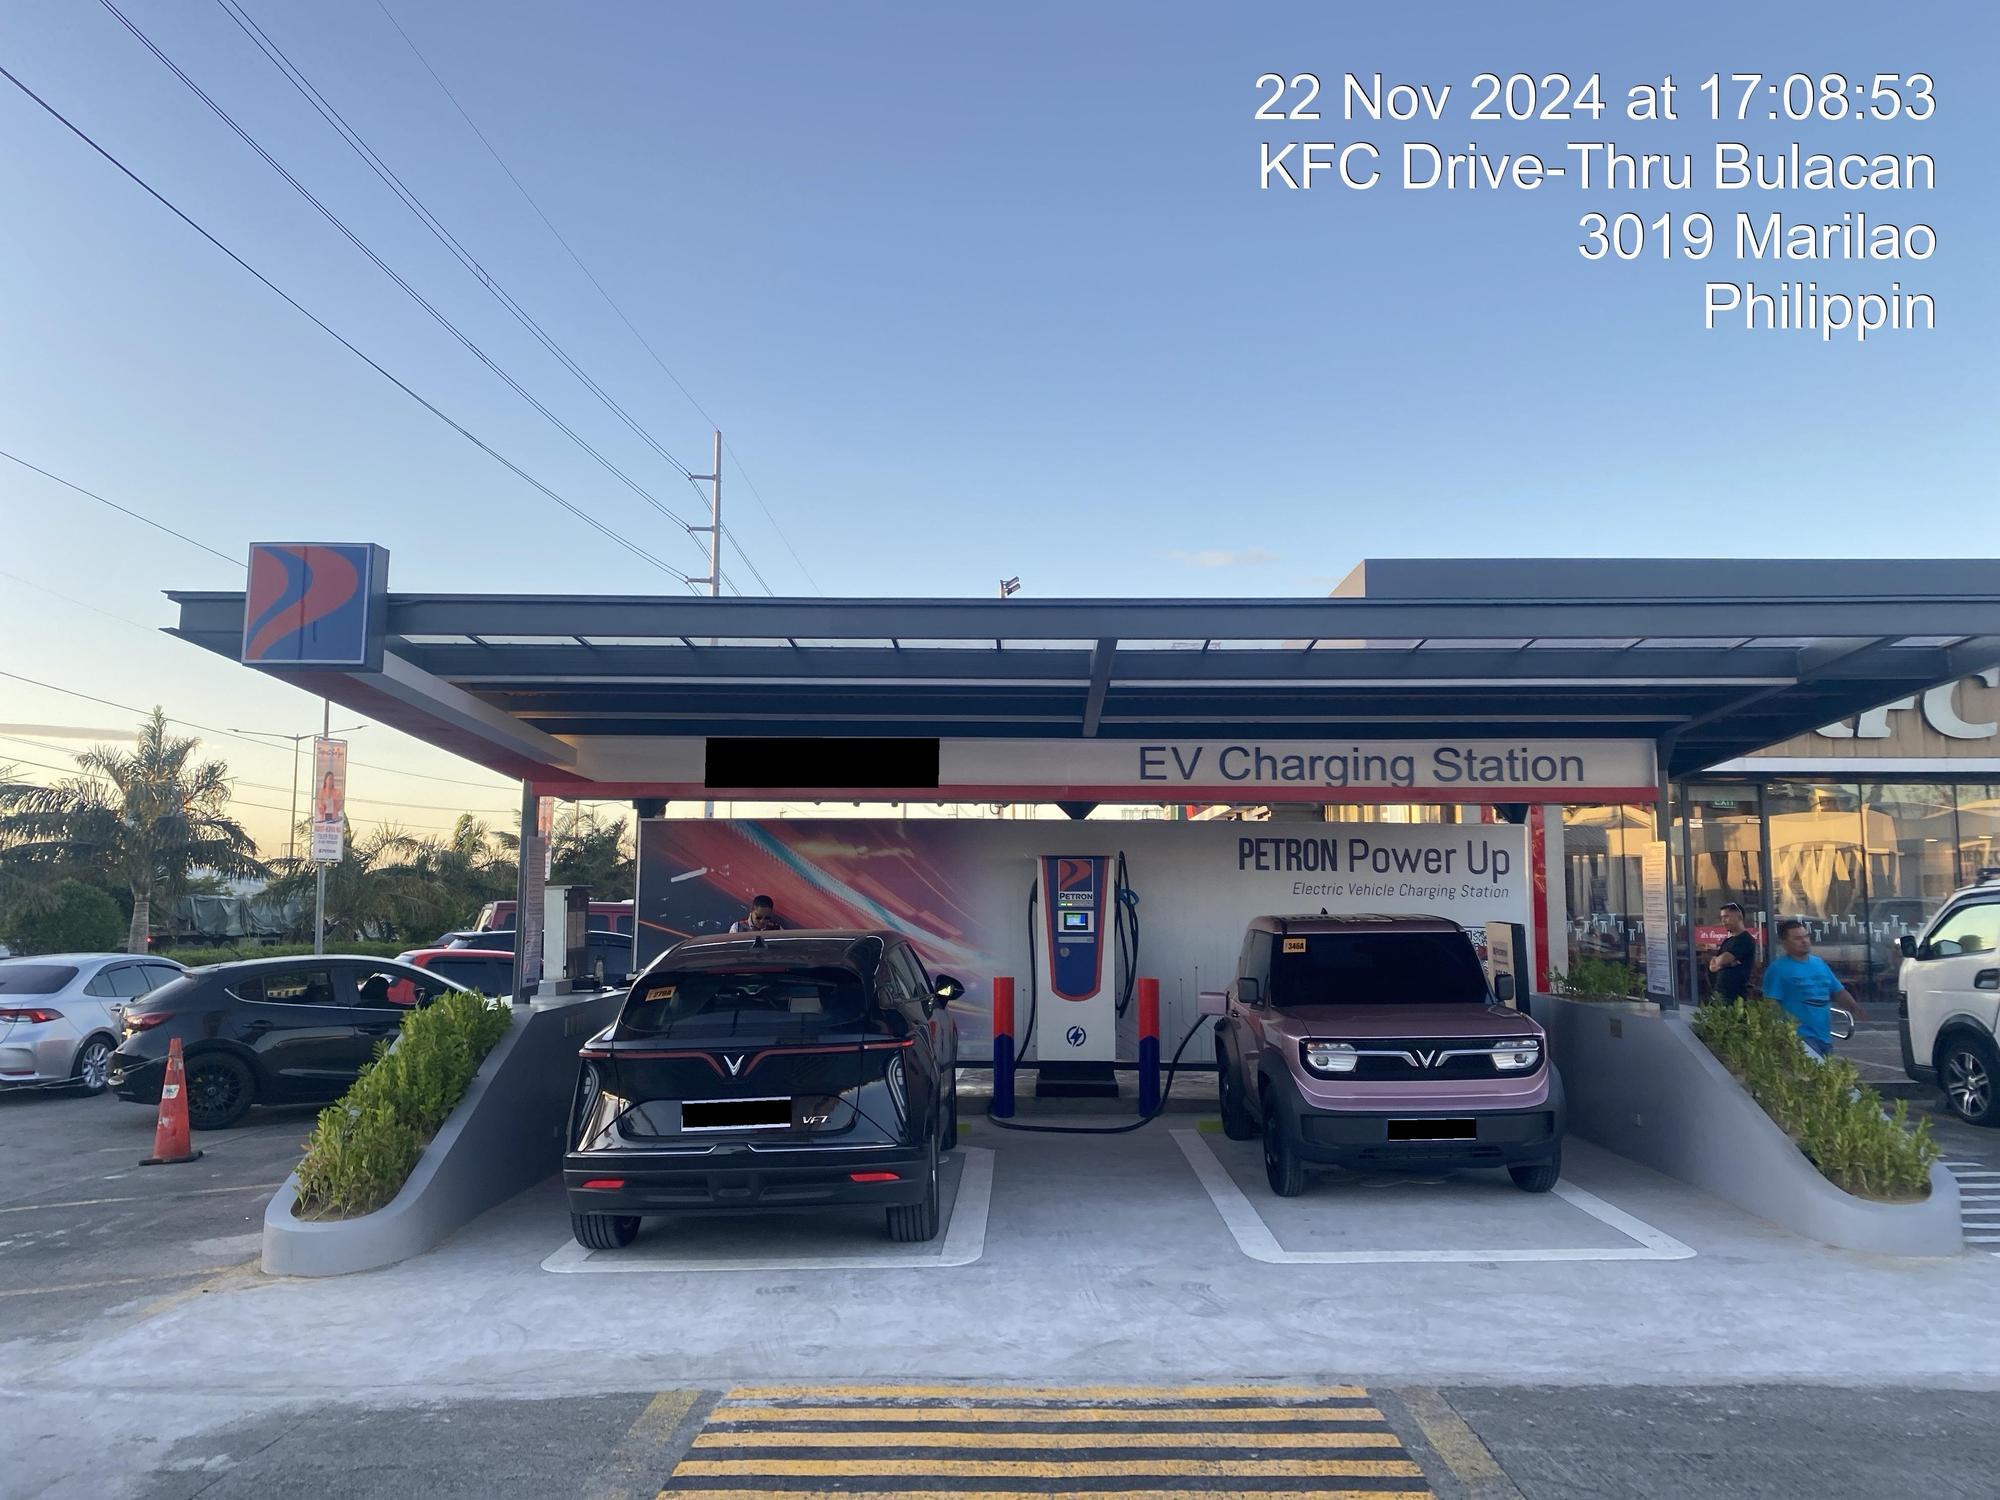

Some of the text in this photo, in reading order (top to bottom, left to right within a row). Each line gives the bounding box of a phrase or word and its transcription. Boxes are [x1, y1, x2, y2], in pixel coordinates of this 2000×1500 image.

[1139, 746, 1584, 787] EV Charging Station
[1238, 838, 1510, 884] PETRON Power Up
[1059, 892, 1093, 900] PETRON
[1293, 881, 1509, 900] Electric Vehicle Charging Station
